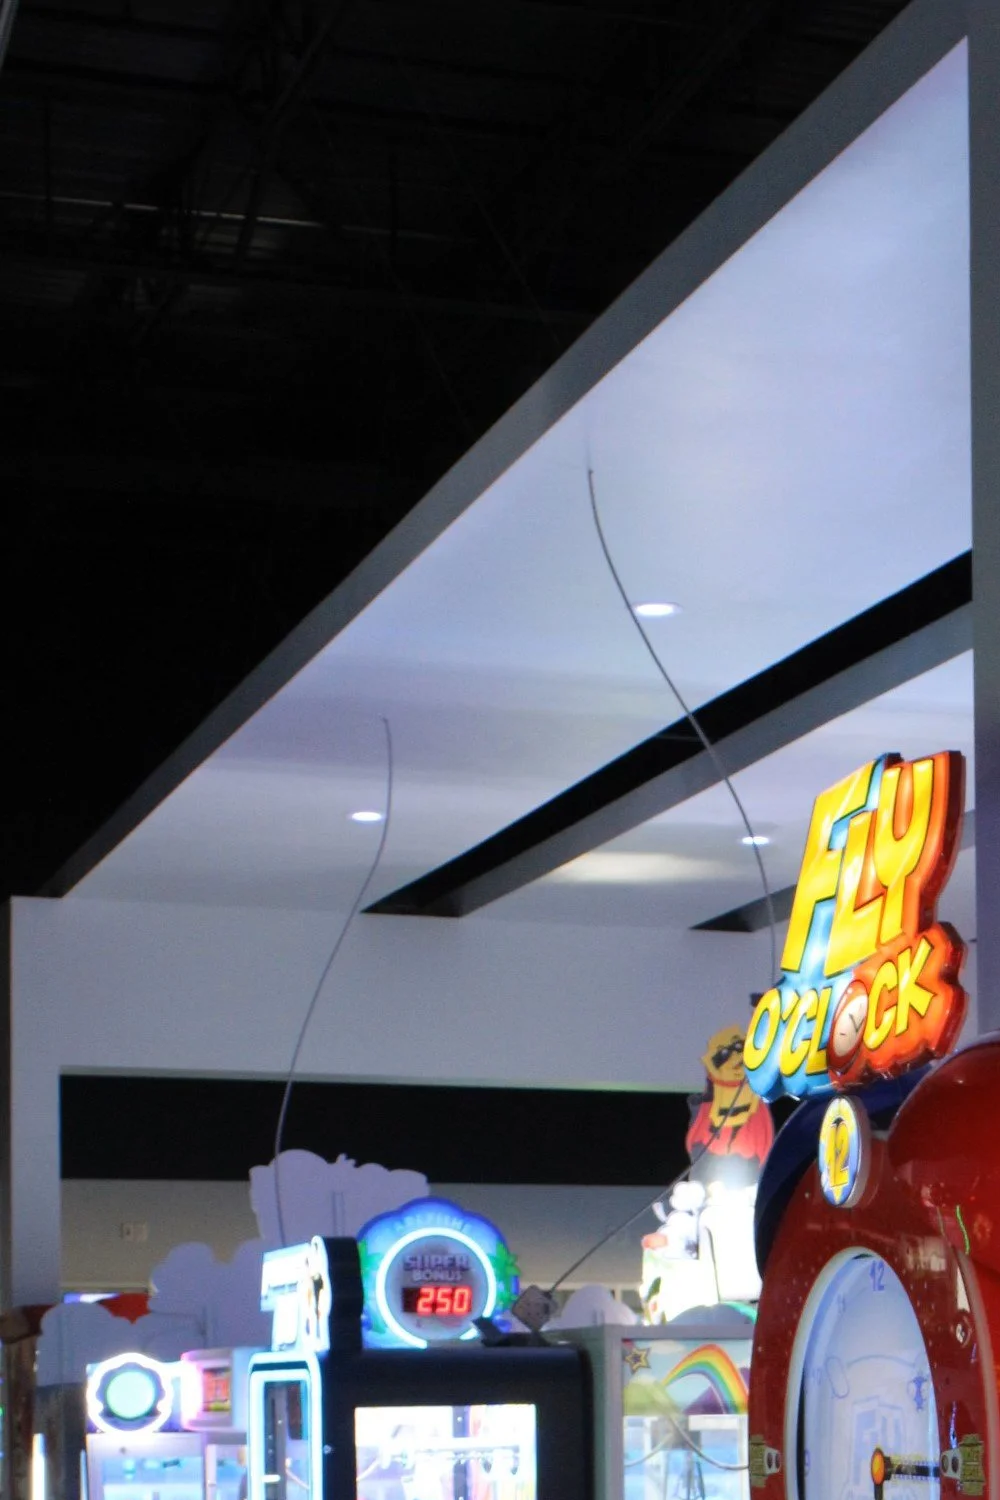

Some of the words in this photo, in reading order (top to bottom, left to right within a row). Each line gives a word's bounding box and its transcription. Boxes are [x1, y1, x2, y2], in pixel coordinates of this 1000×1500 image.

[781, 758, 934, 978] FLY
[743, 934, 936, 1076] O'CLOCK
[823, 1121, 849, 1187] 12
[417, 1286, 471, 1316] 250
[869, 1261, 886, 1292] 12
